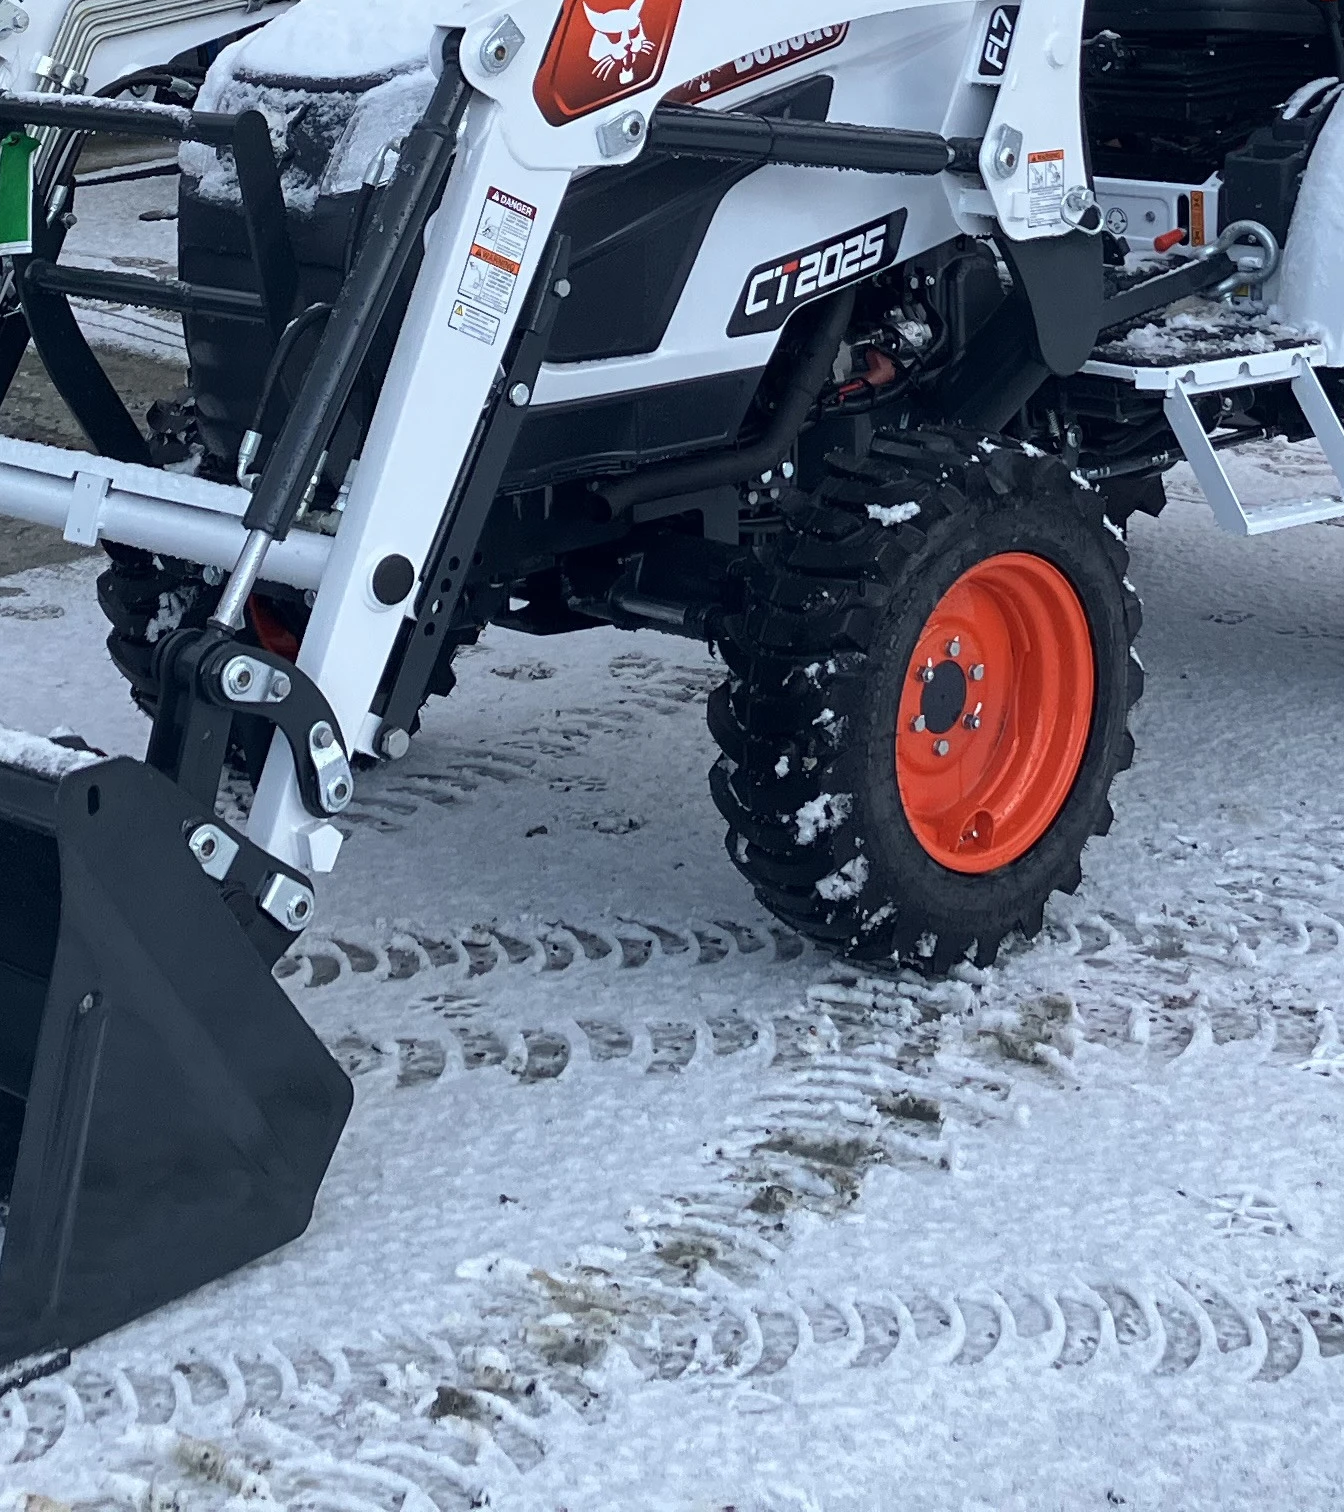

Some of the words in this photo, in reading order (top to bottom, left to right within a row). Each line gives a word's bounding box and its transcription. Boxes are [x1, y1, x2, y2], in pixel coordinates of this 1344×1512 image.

[984, 8, 1012, 70] FL7
[500, 194, 533, 217] DANGER
[745, 224, 887, 316] CT2025
